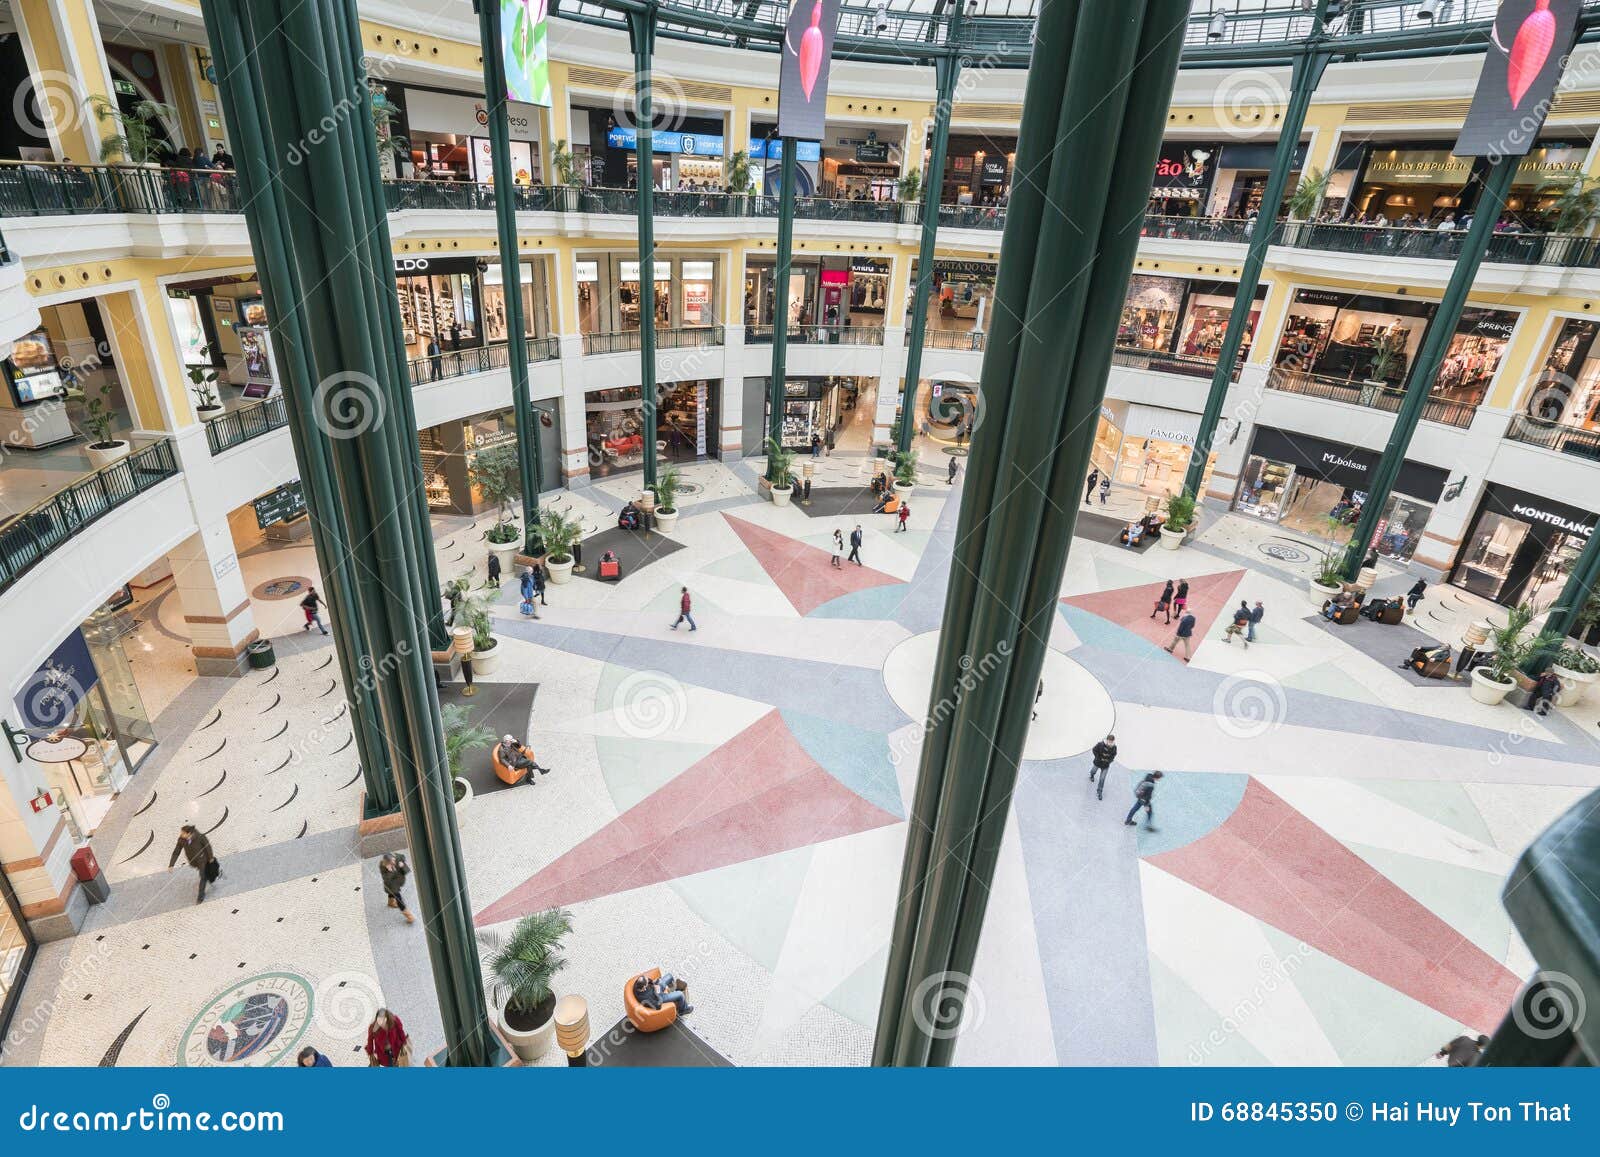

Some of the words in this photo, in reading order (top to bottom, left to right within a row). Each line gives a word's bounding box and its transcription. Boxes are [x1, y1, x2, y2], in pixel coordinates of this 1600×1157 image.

[1373, 161, 1414, 171] ITALIAN
[1308, 293, 1339, 301] HILFIGER
[1150, 427, 1195, 443] PANDORA
[1512, 503, 1595, 537] MONTBLANC
